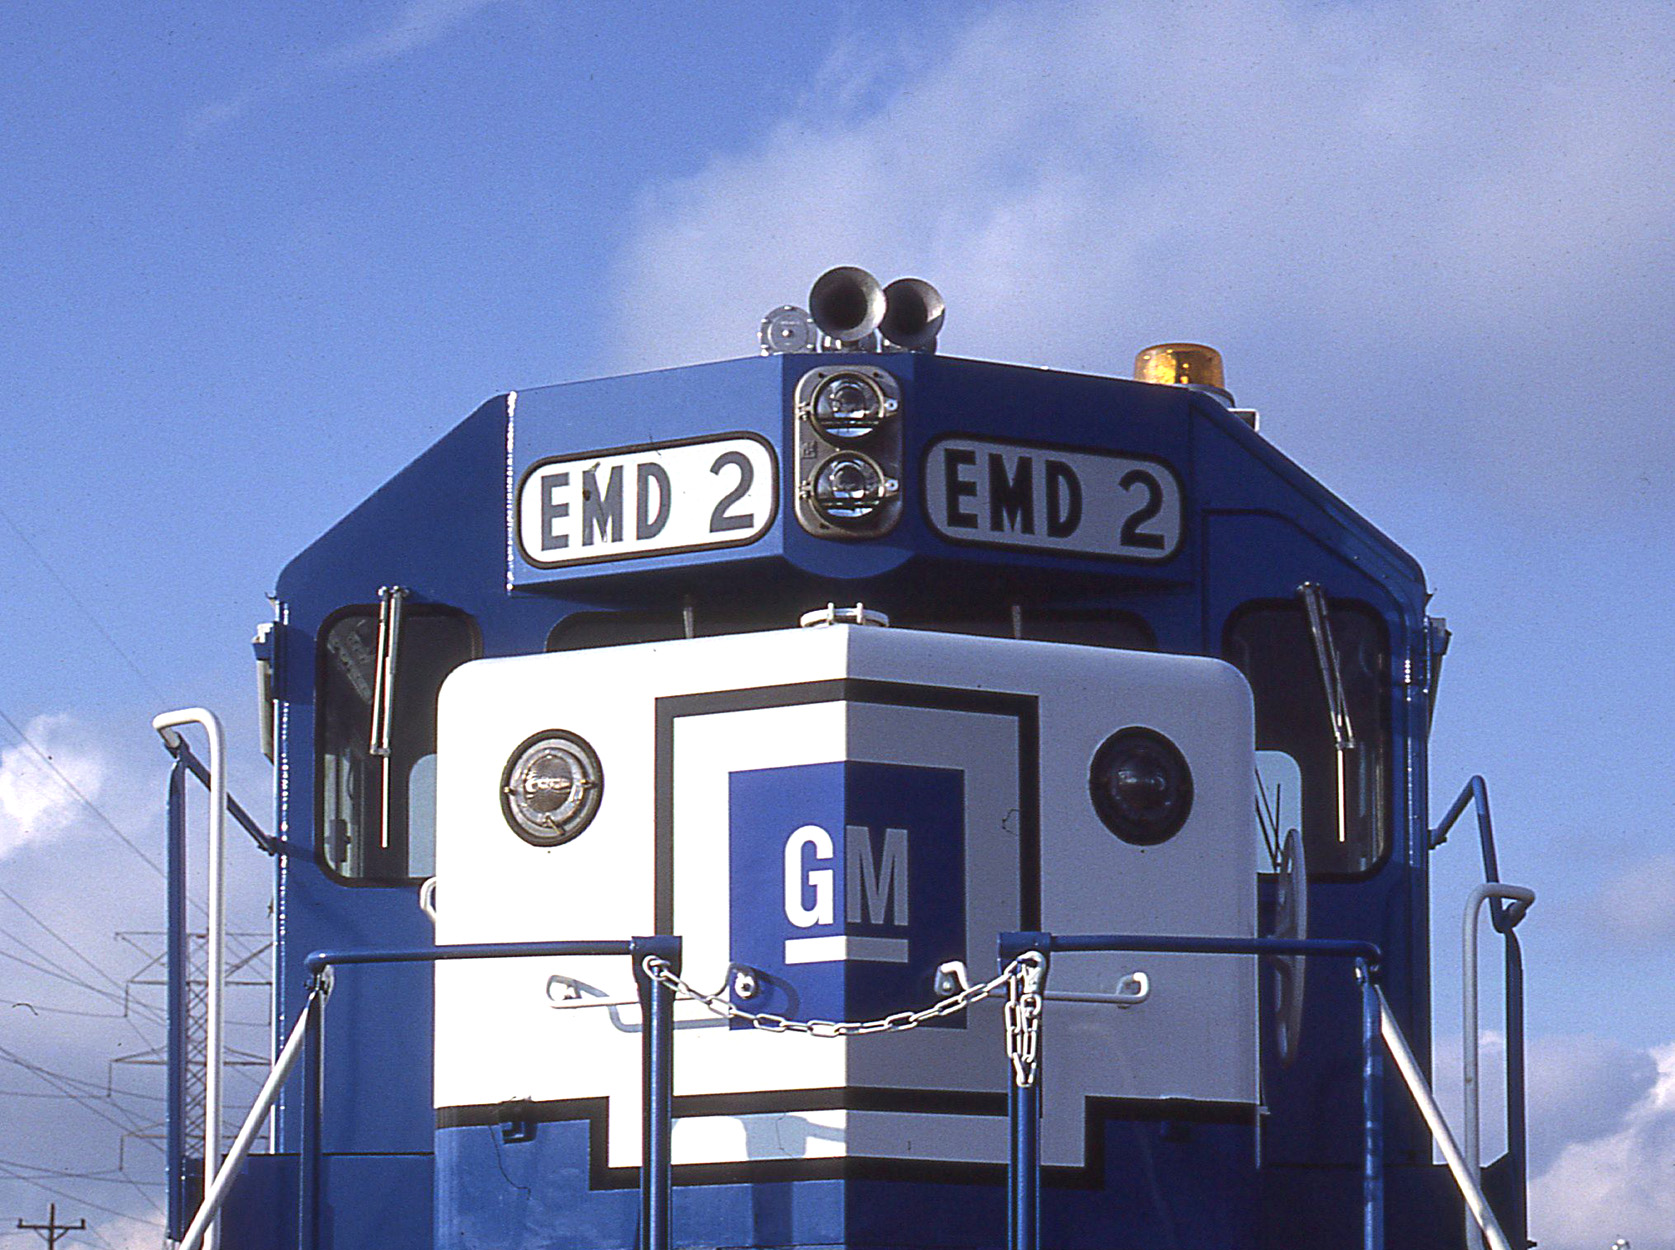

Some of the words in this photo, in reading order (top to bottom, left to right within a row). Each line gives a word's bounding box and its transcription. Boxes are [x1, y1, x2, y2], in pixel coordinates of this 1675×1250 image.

[541, 462, 671, 551] EMD
[710, 451, 754, 533] 2
[944, 448, 1083, 538] EMD
[1118, 469, 1165, 549] 2
[784, 825, 909, 928] GM
